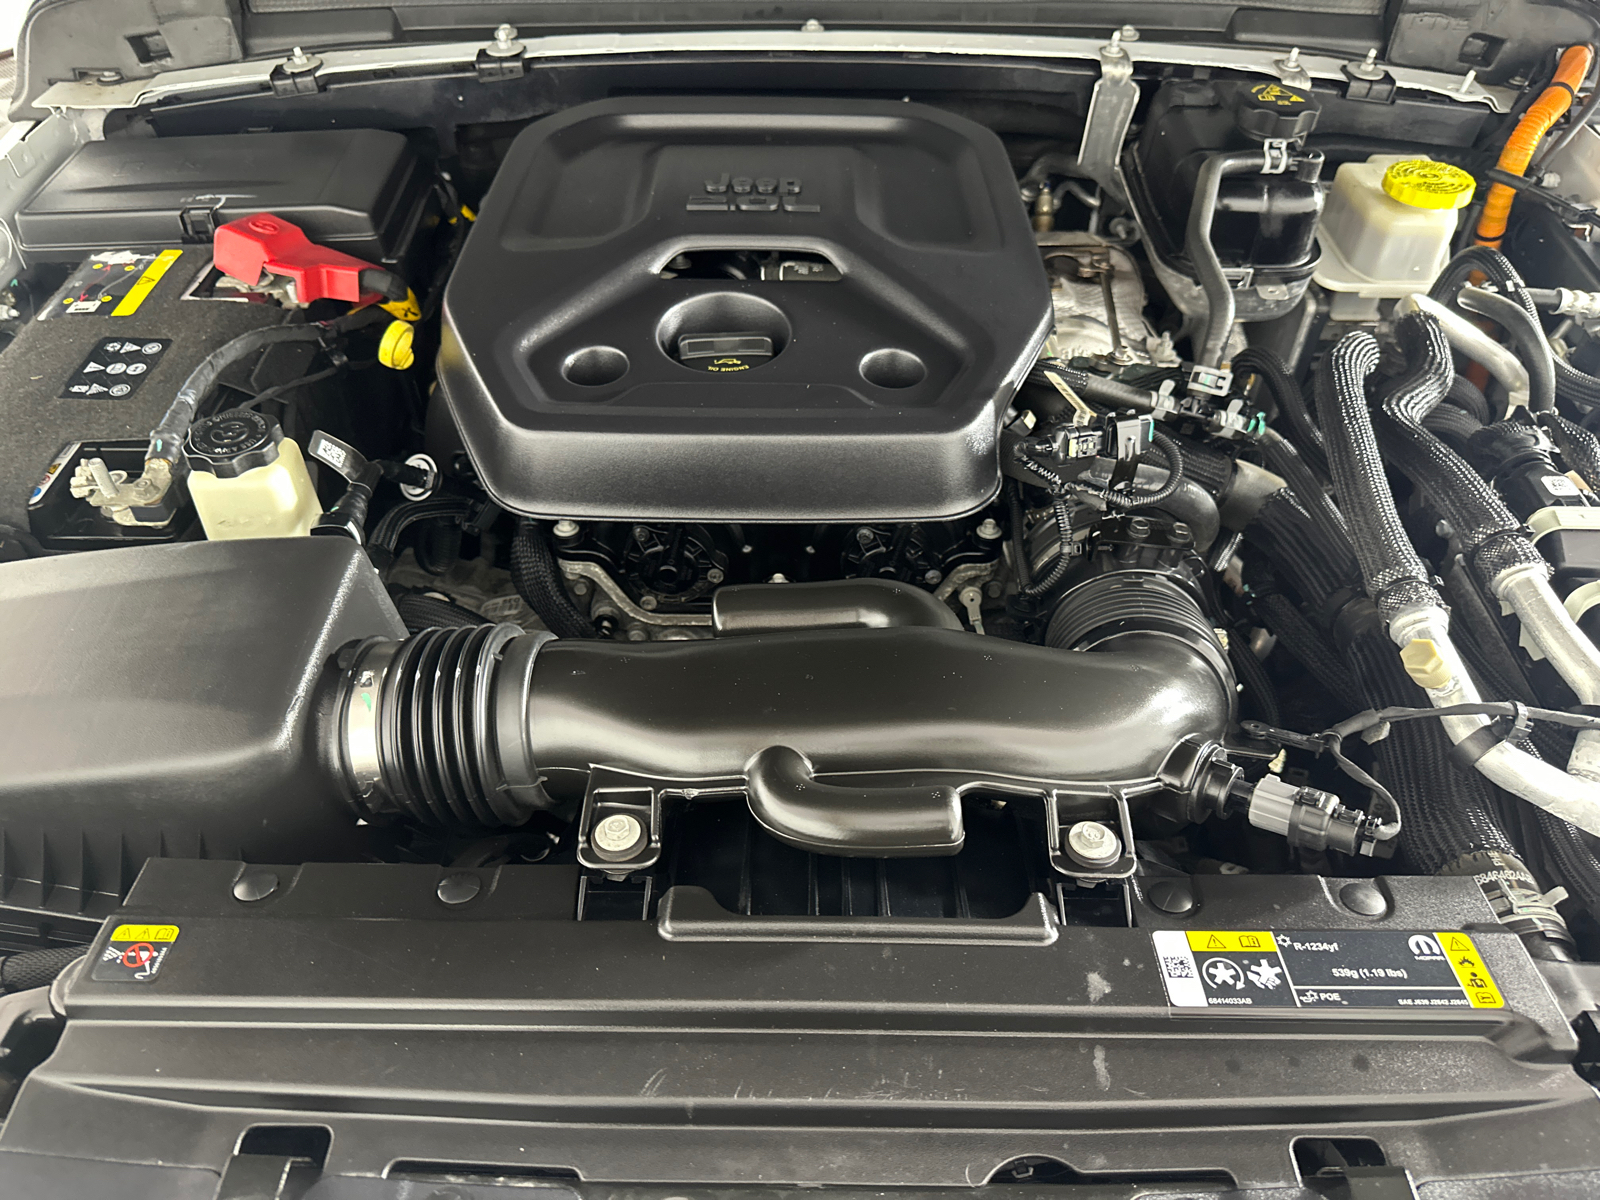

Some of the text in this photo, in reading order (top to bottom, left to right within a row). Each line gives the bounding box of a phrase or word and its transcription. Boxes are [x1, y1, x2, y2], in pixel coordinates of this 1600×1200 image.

[704, 173, 802, 193] Jeep
[1293, 942, 1339, 952] R-1234yf
[1331, 968, 1408, 979] 539g (1.19 lbs)
[1208, 997, 1253, 1005] 68414033AB
[1319, 993, 1341, 1001] POE
